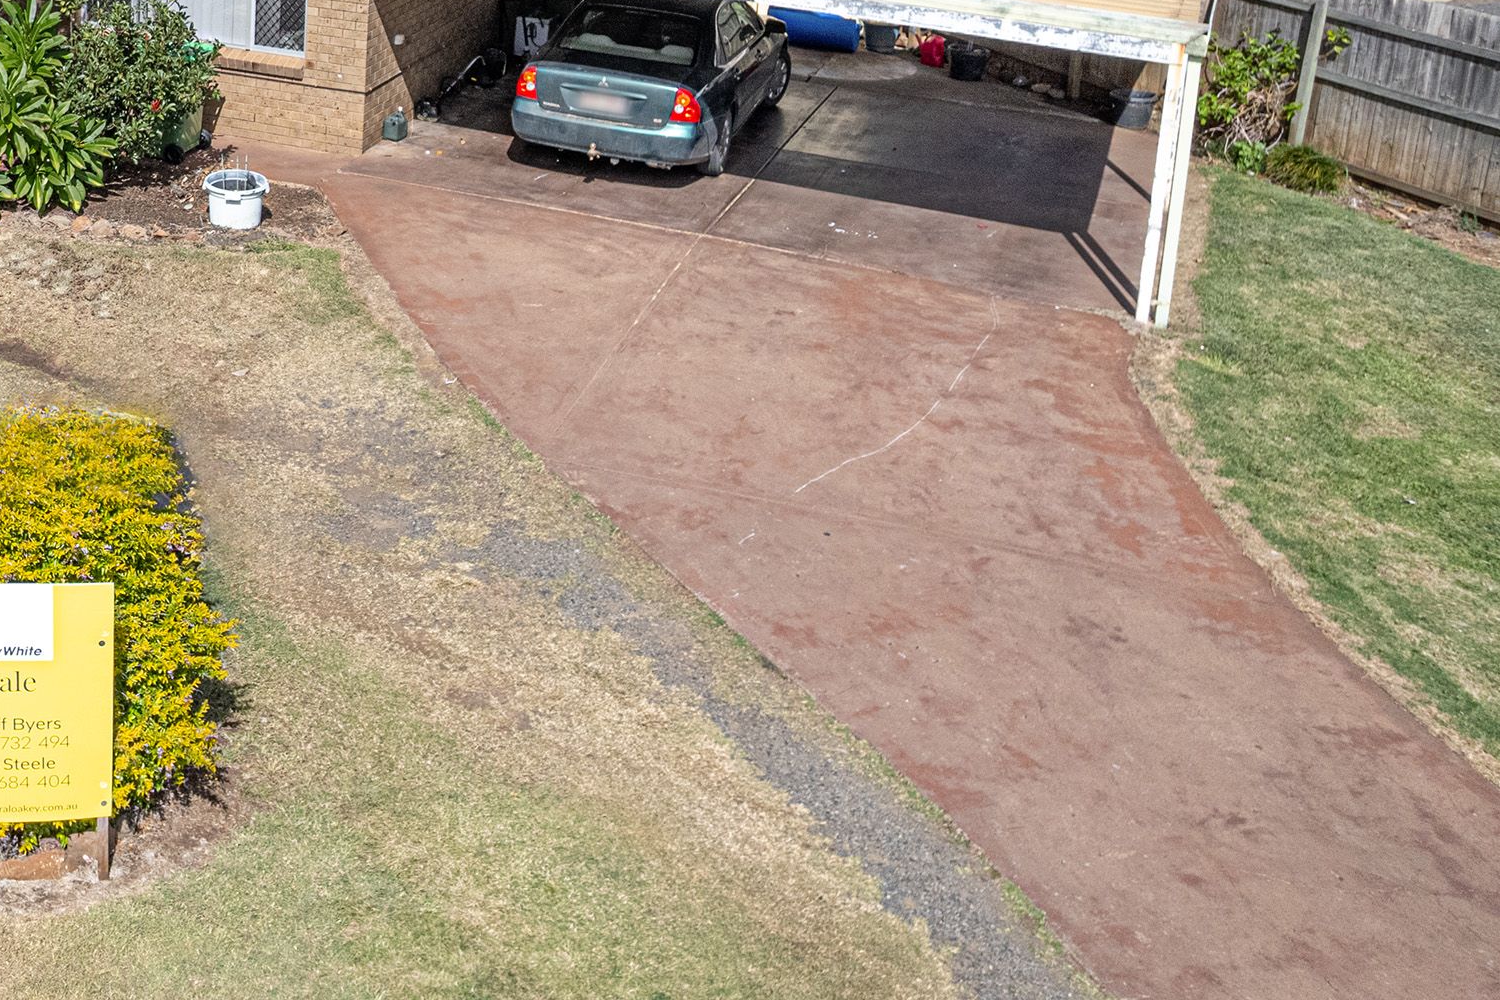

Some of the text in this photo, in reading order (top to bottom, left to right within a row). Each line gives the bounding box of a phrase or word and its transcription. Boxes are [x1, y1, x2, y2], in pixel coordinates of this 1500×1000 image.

[12, 717, 62, 733] Byers
[0, 735, 32, 750] 732
[38, 735, 70, 749] 494
[3, 756, 56, 771] Steele
[36, 774, 71, 788] 404
